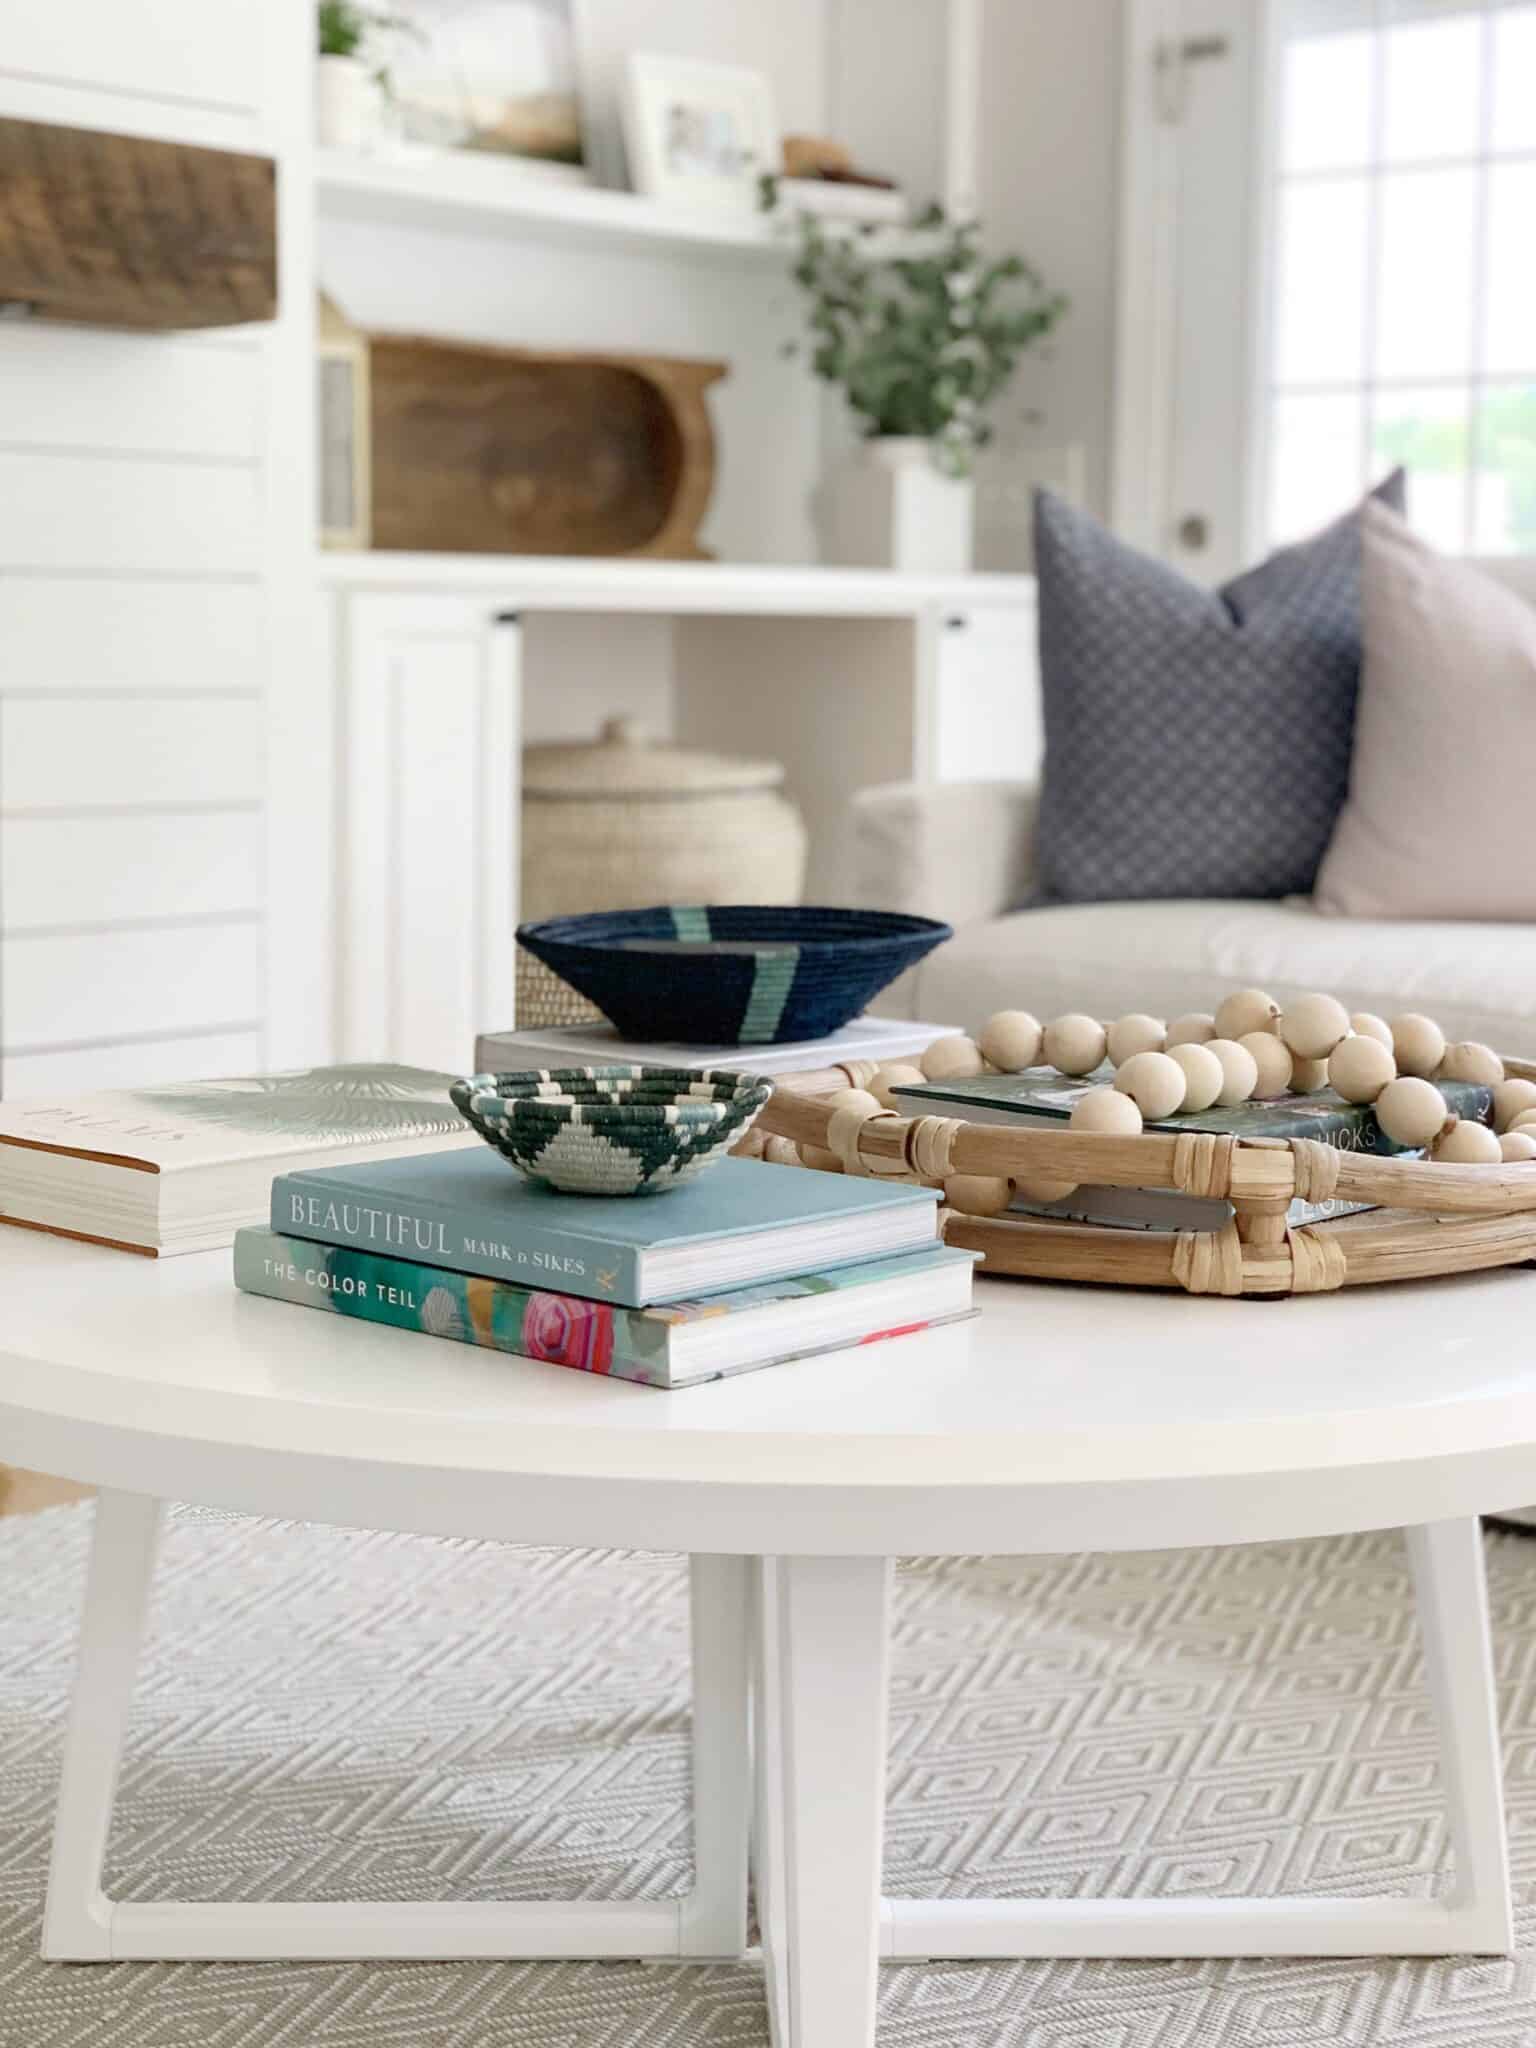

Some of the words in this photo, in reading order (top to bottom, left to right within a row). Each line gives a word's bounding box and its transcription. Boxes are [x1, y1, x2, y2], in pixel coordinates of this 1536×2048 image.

[289, 1193, 452, 1254] BEAUTIFUL
[463, 1237, 512, 1261] MARK
[532, 1250, 585, 1276] SIKES
[264, 1259, 297, 1281] THE
[304, 1269, 367, 1297] COLOR
[376, 1283, 416, 1309] TEIL
